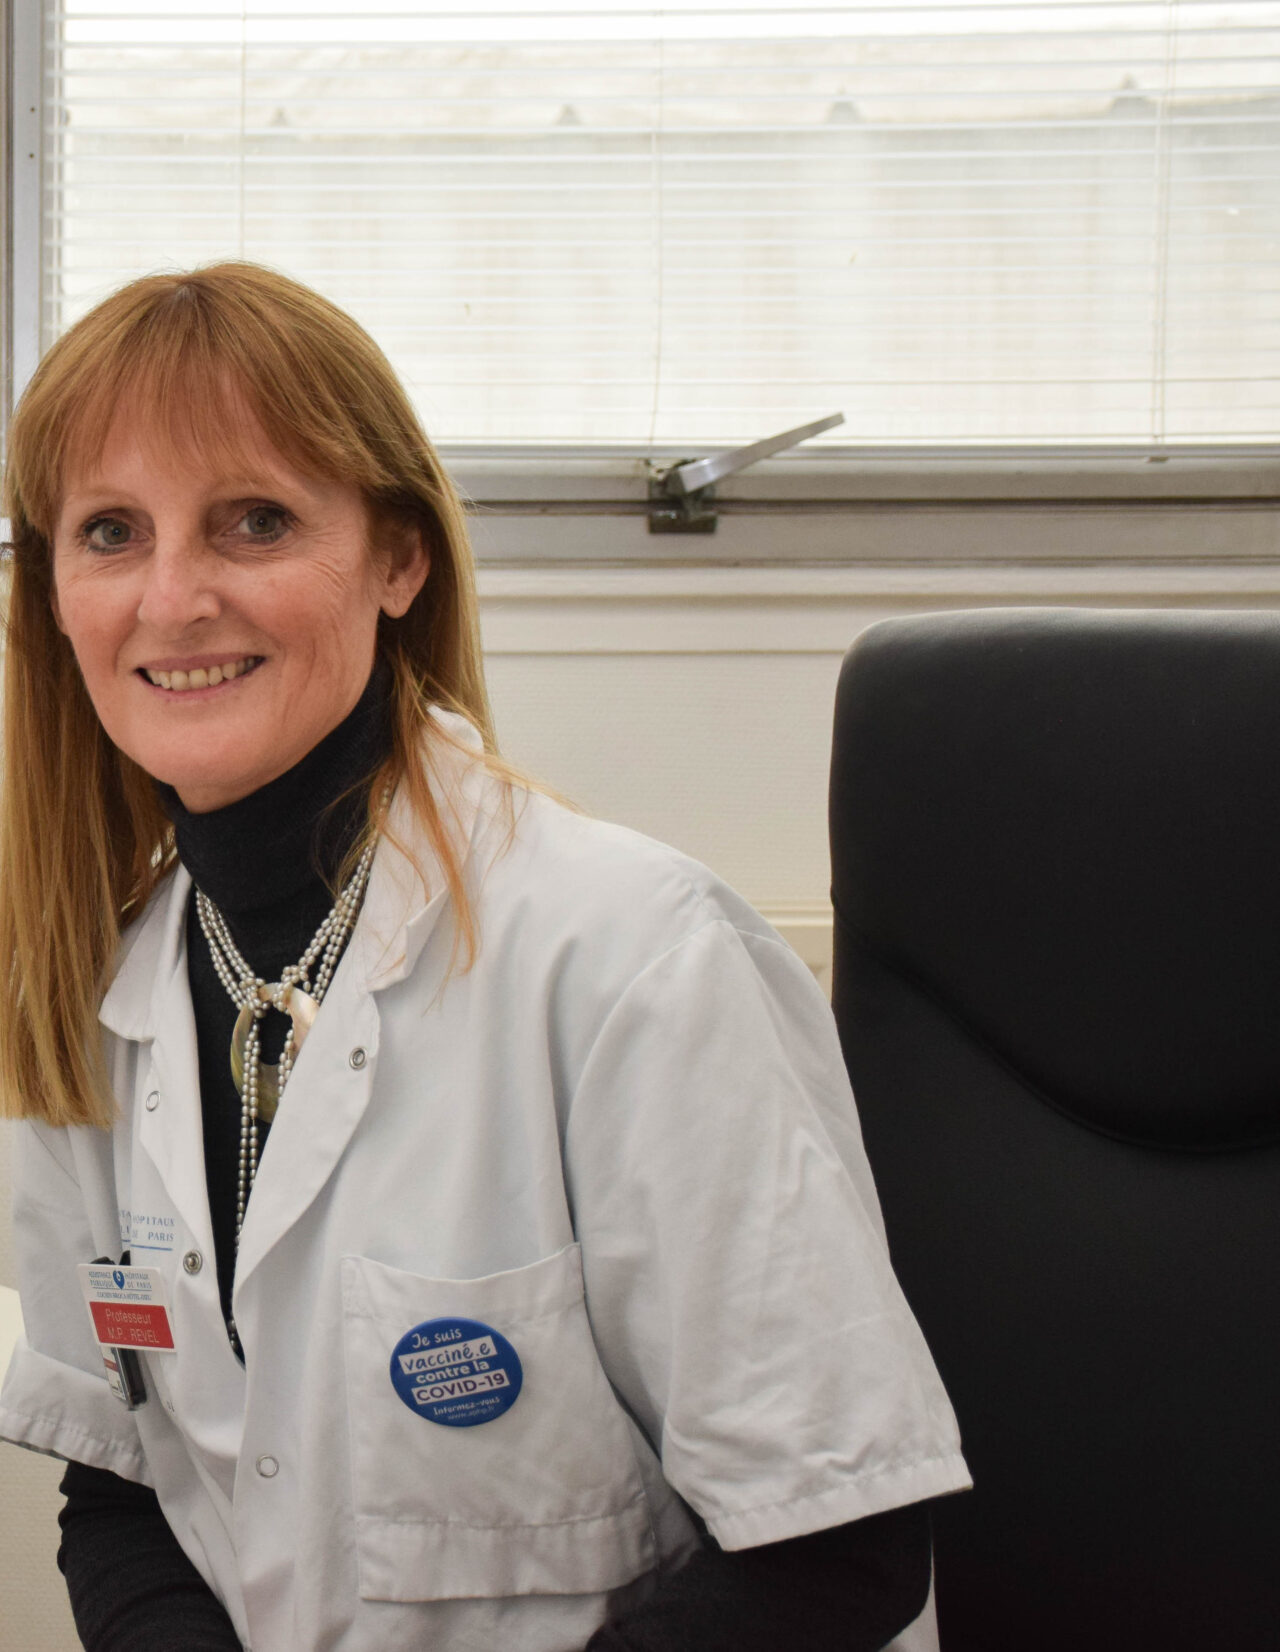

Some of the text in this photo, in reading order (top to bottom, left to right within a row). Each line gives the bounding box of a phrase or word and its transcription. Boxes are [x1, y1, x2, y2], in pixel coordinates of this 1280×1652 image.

[148, 1231, 175, 1241] PARIS
[105, 1308, 151, 1325] Professeur
[130, 1328, 160, 1343] REVEL
[411, 1328, 462, 1348] Je suis
[404, 1341, 491, 1371] vacciné.e
[415, 1360, 490, 1384] contre la
[416, 1372, 506, 1402] COVID-19
